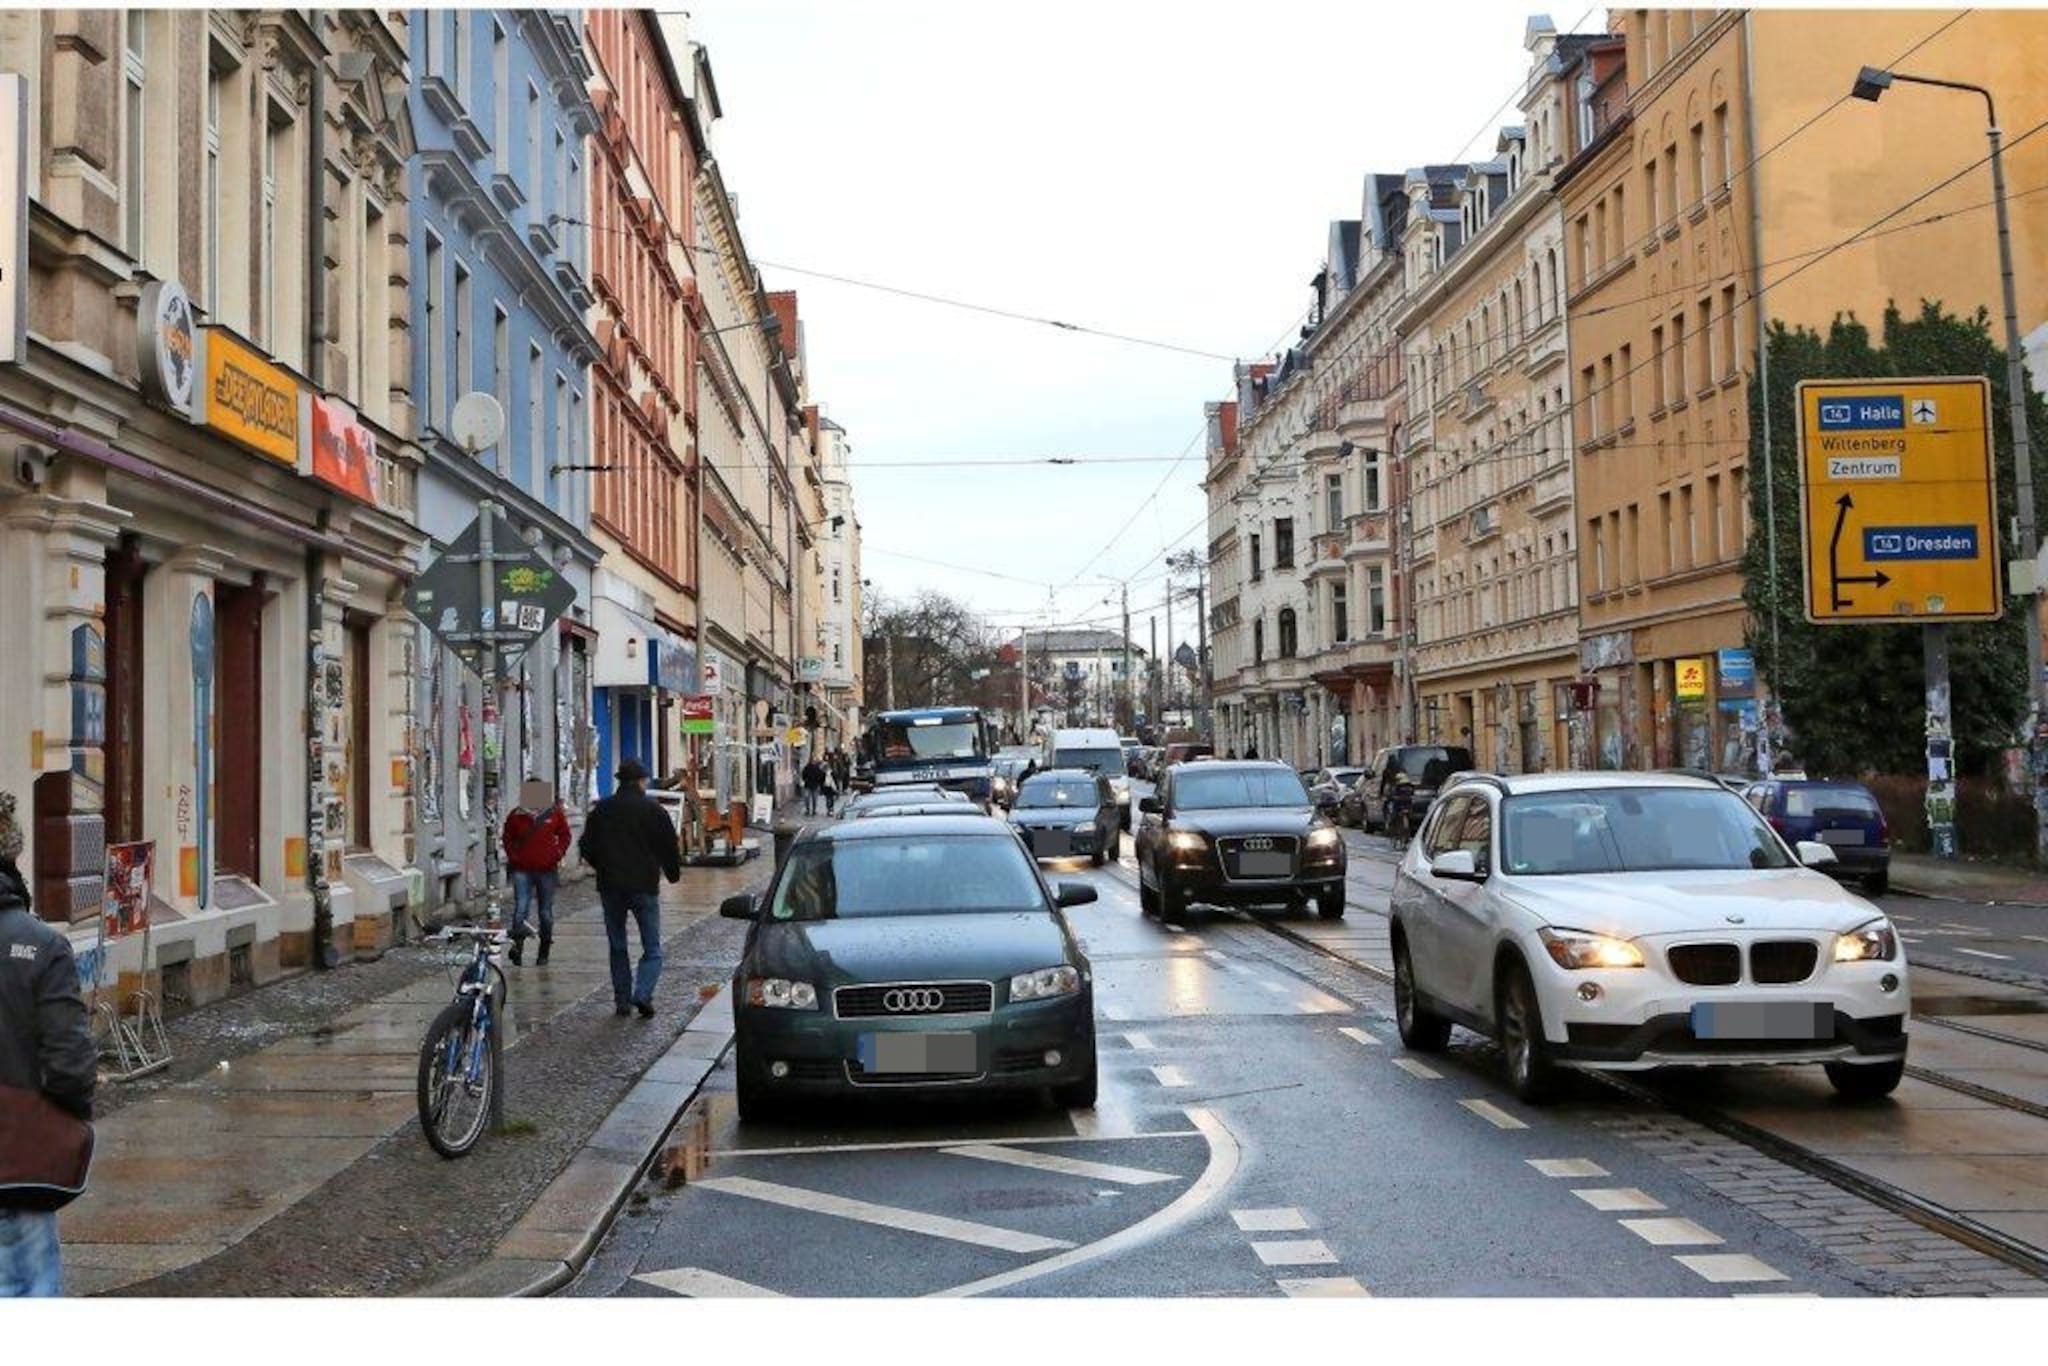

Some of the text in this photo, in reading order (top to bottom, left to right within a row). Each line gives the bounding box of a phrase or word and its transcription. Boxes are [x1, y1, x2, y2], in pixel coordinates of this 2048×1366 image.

[1831, 406, 1900, 420] 14 Halle
[1822, 436, 1906, 453] Wittenberg
[1831, 461, 1898, 476] Zentrum
[1880, 535, 1972, 551] 14 Dresden
